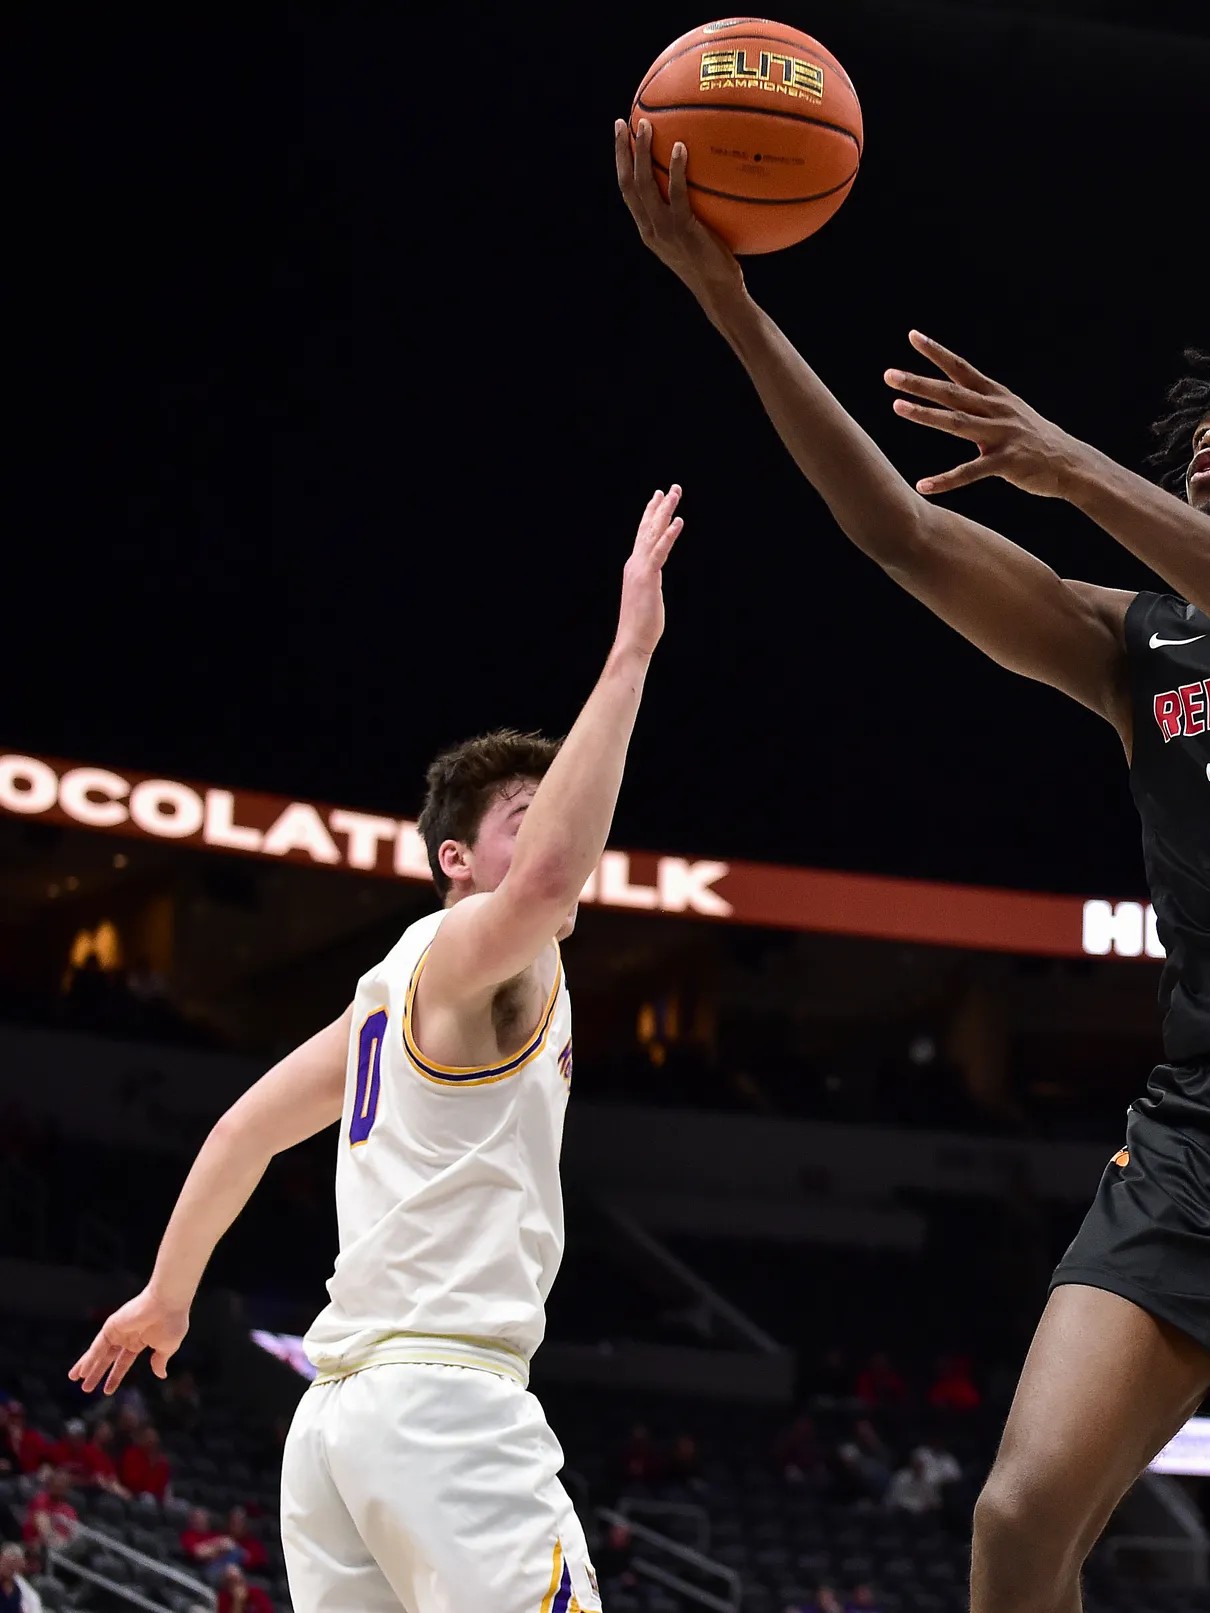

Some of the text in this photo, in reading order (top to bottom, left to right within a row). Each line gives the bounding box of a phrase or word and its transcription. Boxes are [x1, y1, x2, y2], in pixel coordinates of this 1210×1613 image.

[700, 49, 824, 98] ELITE
[577, 850, 734, 917] LK
[349, 1004, 389, 1148] 0
